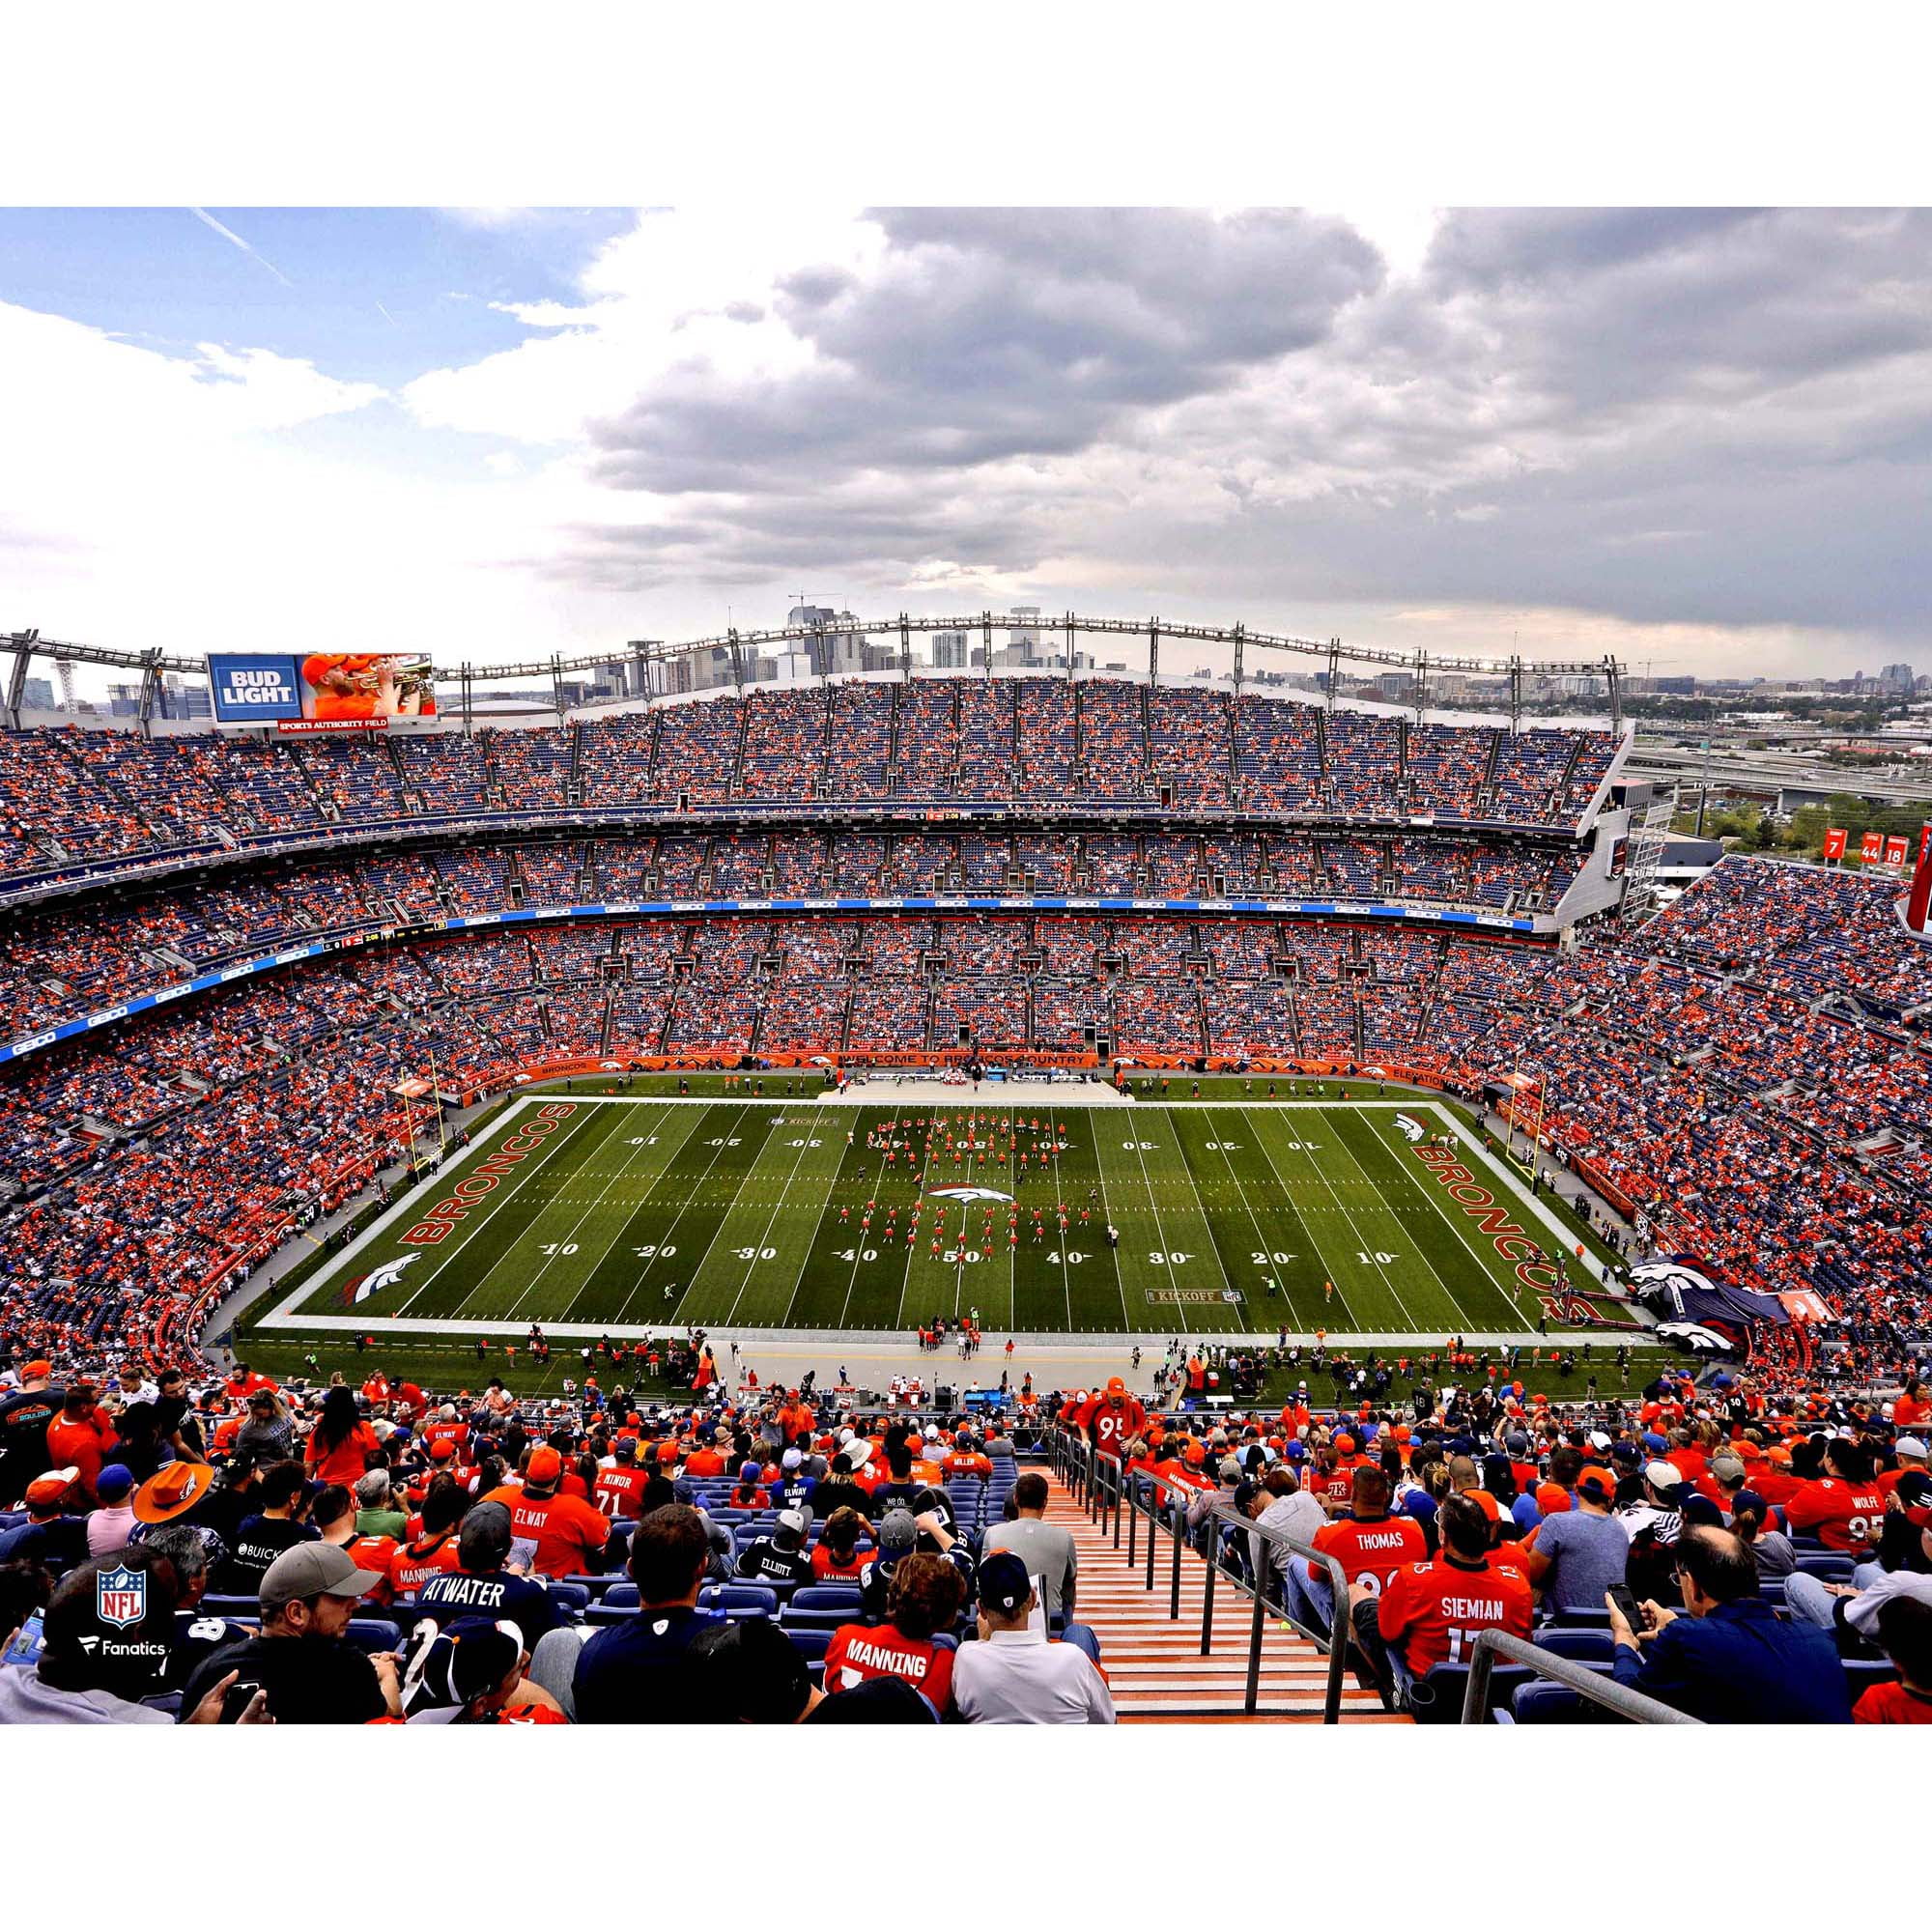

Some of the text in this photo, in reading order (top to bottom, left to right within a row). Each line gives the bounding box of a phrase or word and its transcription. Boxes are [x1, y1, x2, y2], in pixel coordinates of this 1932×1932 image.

[230, 670, 281, 688] BUD
[223, 687, 292, 704] LIGHT
[279, 722, 312, 730] SPORTS
[314, 720, 363, 729] AUTHORITY
[1829, 841, 1838, 854] 7
[1861, 846, 1878, 859] 44
[1887, 849, 1902, 863] 18
[88, 1006, 128, 1027] GEICO
[13, 1032, 56, 1056] GEICO
[921, 1055, 940, 1064] TO
[397, 1102, 579, 1245] BRONCOS
[1410, 1146, 1604, 1327] BRONCOS
[543, 1242, 580, 1255] 10
[636, 1244, 677, 1257] 20
[739, 1247, 777, 1260] 30
[840, 1248, 878, 1262] 40
[1045, 1251, 1083, 1264] 40
[1149, 1252, 1186, 1264] 30
[1251, 1252, 1290, 1264] 20
[1356, 1251, 1392, 1264] 10
[1158, 1292, 1214, 1301] KICKOFF
[435, 1431, 456, 1439] ELWAY
[604, 1473, 633, 1489] MINOR
[783, 1487, 808, 1497] ELWAY
[596, 1490, 621, 1516] 71
[1852, 1496, 1879, 1510] WOLFE
[514, 1508, 548, 1528] ELWAY
[1356, 1531, 1404, 1550] THOMAS
[246, 1545, 282, 1560] BUICK
[761, 1557, 792, 1577] ELLIOTT
[422, 1577, 505, 1607] ATWATER
[1441, 1597, 1503, 1620] SIEMIAN
[846, 1638, 927, 1678] MANNING
